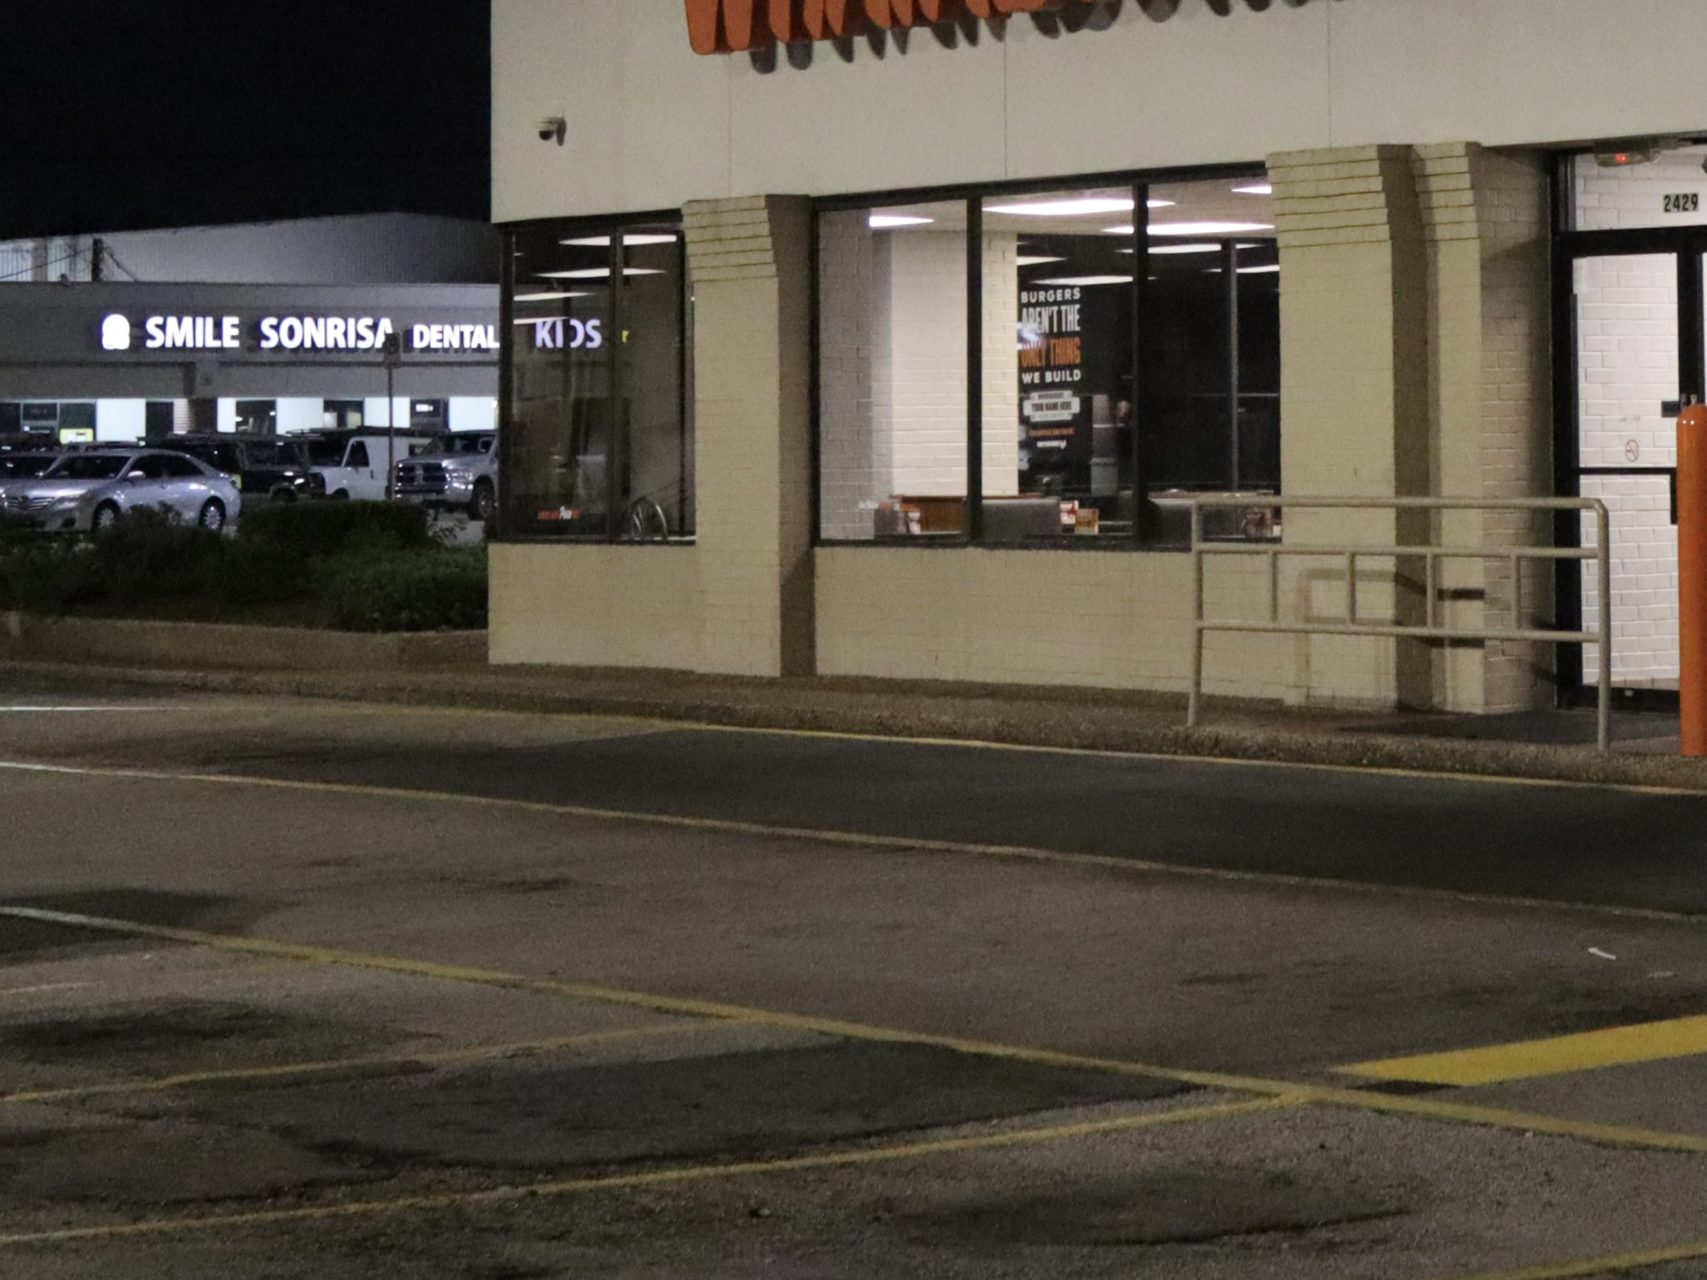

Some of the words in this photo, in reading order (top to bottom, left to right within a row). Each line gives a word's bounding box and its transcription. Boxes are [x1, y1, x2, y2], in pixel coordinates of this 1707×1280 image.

[1664, 193, 1699, 213] 2429
[1021, 287, 1081, 303] BURGERS
[1022, 306, 1058, 333] AREN'T
[1061, 304, 1081, 332] THE
[145, 316, 240, 349] SMILE
[260, 317, 393, 349] SONRISA
[412, 324, 500, 348] DENTAL
[535, 319, 602, 349] KIDS
[1050, 337, 1081, 366] THING
[1022, 372, 1040, 384] WE
[1045, 369, 1081, 383] BUILD
